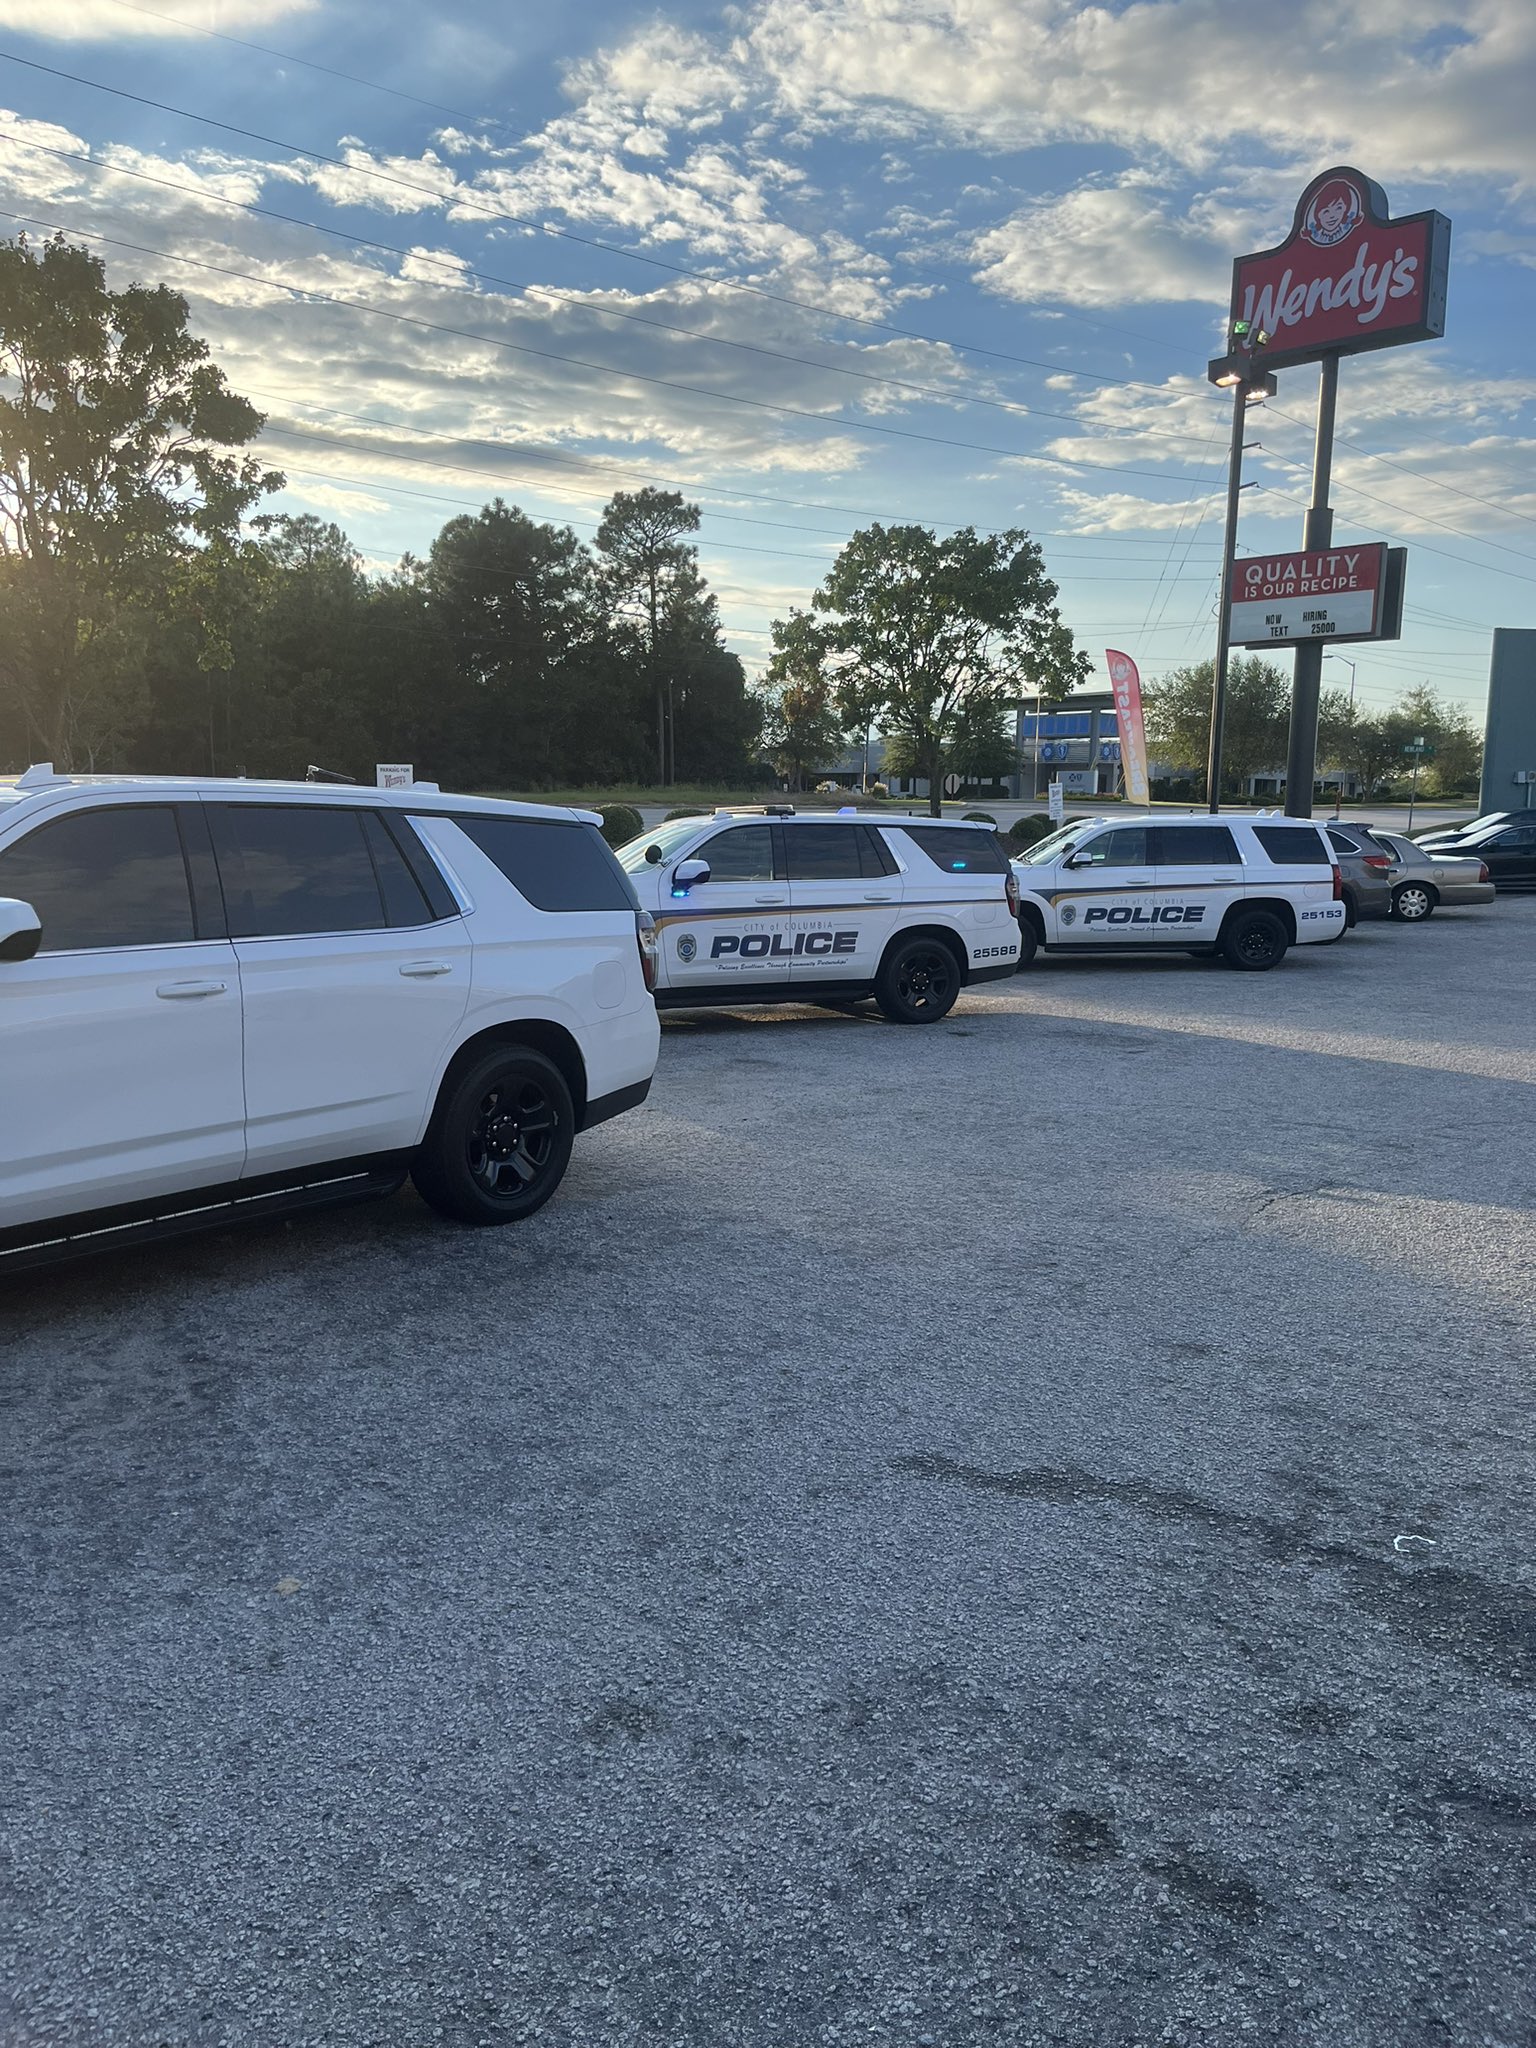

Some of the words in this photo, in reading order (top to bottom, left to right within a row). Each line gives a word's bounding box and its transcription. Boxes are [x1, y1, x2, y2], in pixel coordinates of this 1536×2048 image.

[1243, 242, 1418, 349] Wendy's
[1245, 553, 1360, 585] QUALITY
[1244, 586, 1257, 598] IS
[1263, 582, 1294, 597] OUR
[1300, 575, 1358, 593] RECIPE
[1265, 614, 1282, 625] NOW
[1302, 610, 1327, 622] HIRING
[1270, 626, 1289, 637] TEXT
[1311, 622, 1336, 634] 25000
[1111, 898, 1128, 906] CITY
[1144, 897, 1184, 905] COLUMBIA
[1083, 906, 1206, 924] POLICE
[1302, 910, 1342, 919] 25153
[743, 923, 764, 932] CITY
[770, 922, 779, 931] of
[784, 921, 833, 931] COLUMBIA
[710, 931, 859, 959] POLICE
[973, 945, 1017, 958] 25588
